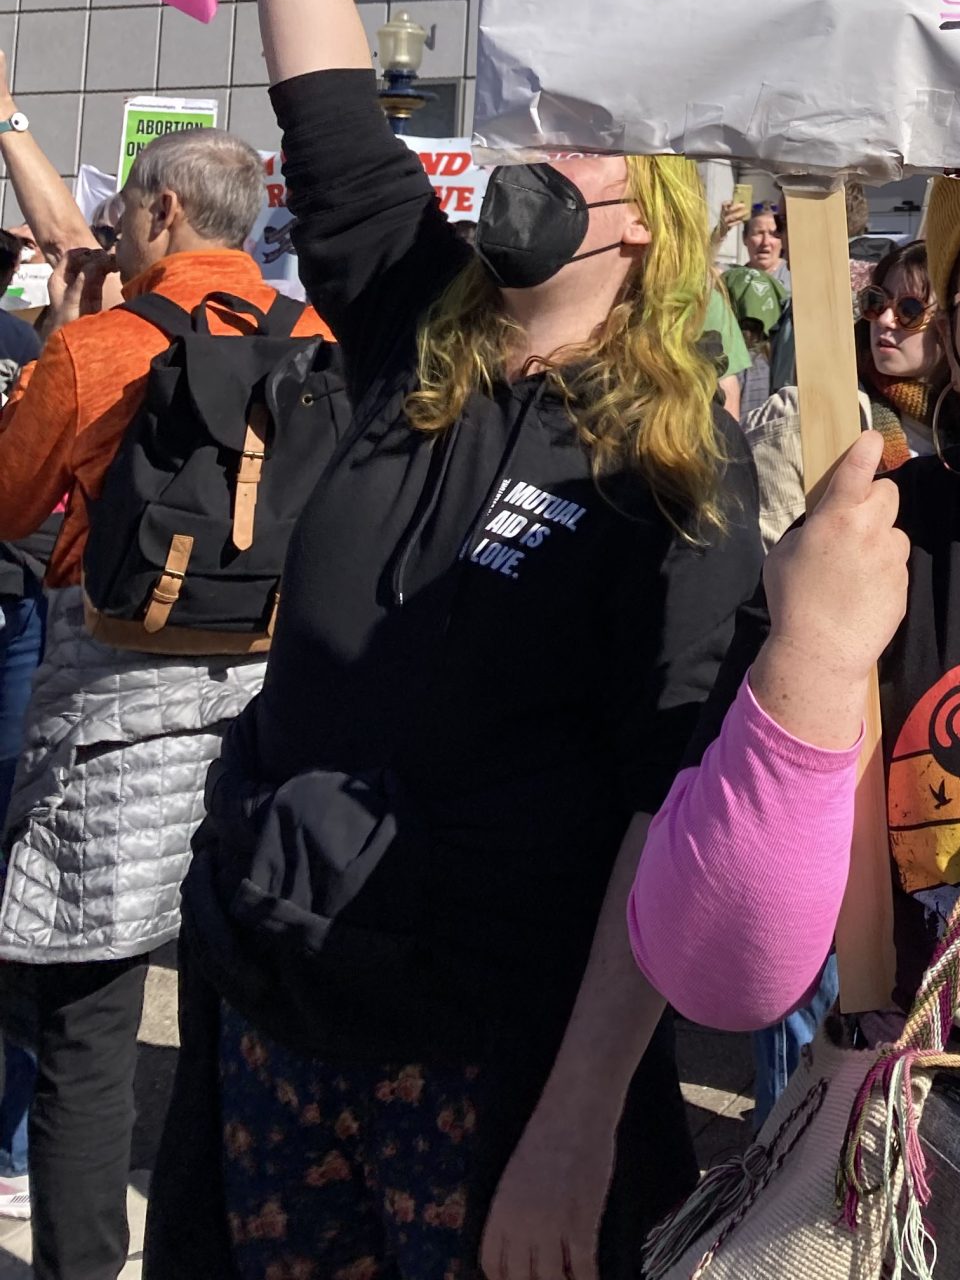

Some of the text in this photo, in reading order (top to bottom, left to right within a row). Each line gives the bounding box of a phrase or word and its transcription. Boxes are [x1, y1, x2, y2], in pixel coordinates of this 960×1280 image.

[504, 481, 587, 533] MUTUAL
[484, 509, 551, 548] AID IS
[470, 538, 525, 580] LOVE.
